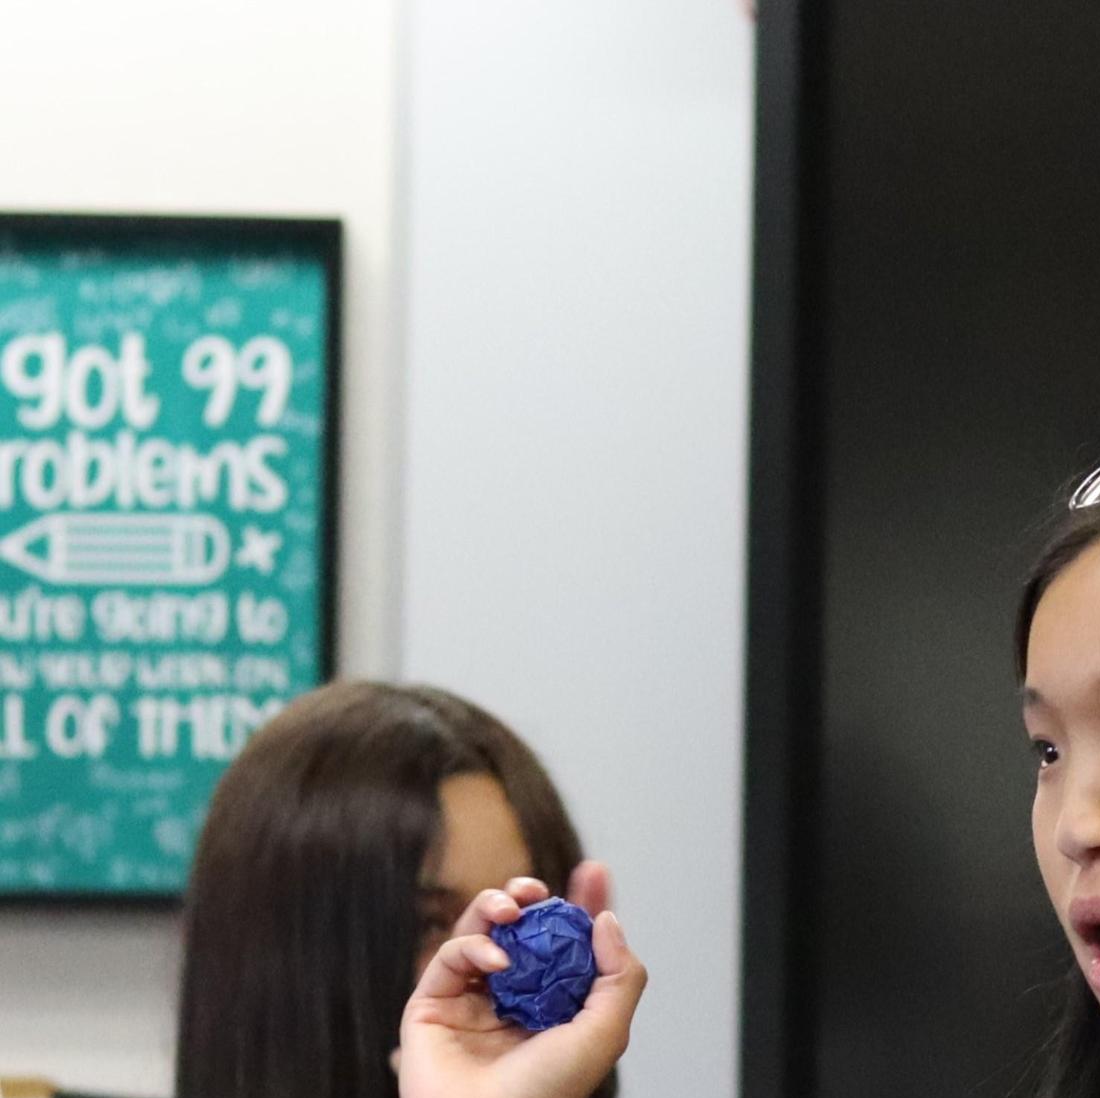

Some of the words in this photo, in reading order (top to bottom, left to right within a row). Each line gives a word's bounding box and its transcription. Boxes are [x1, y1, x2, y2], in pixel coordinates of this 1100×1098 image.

[2, 331, 160, 431] got
[181, 334, 294, 428] 99
[236, 591, 289, 645] to
